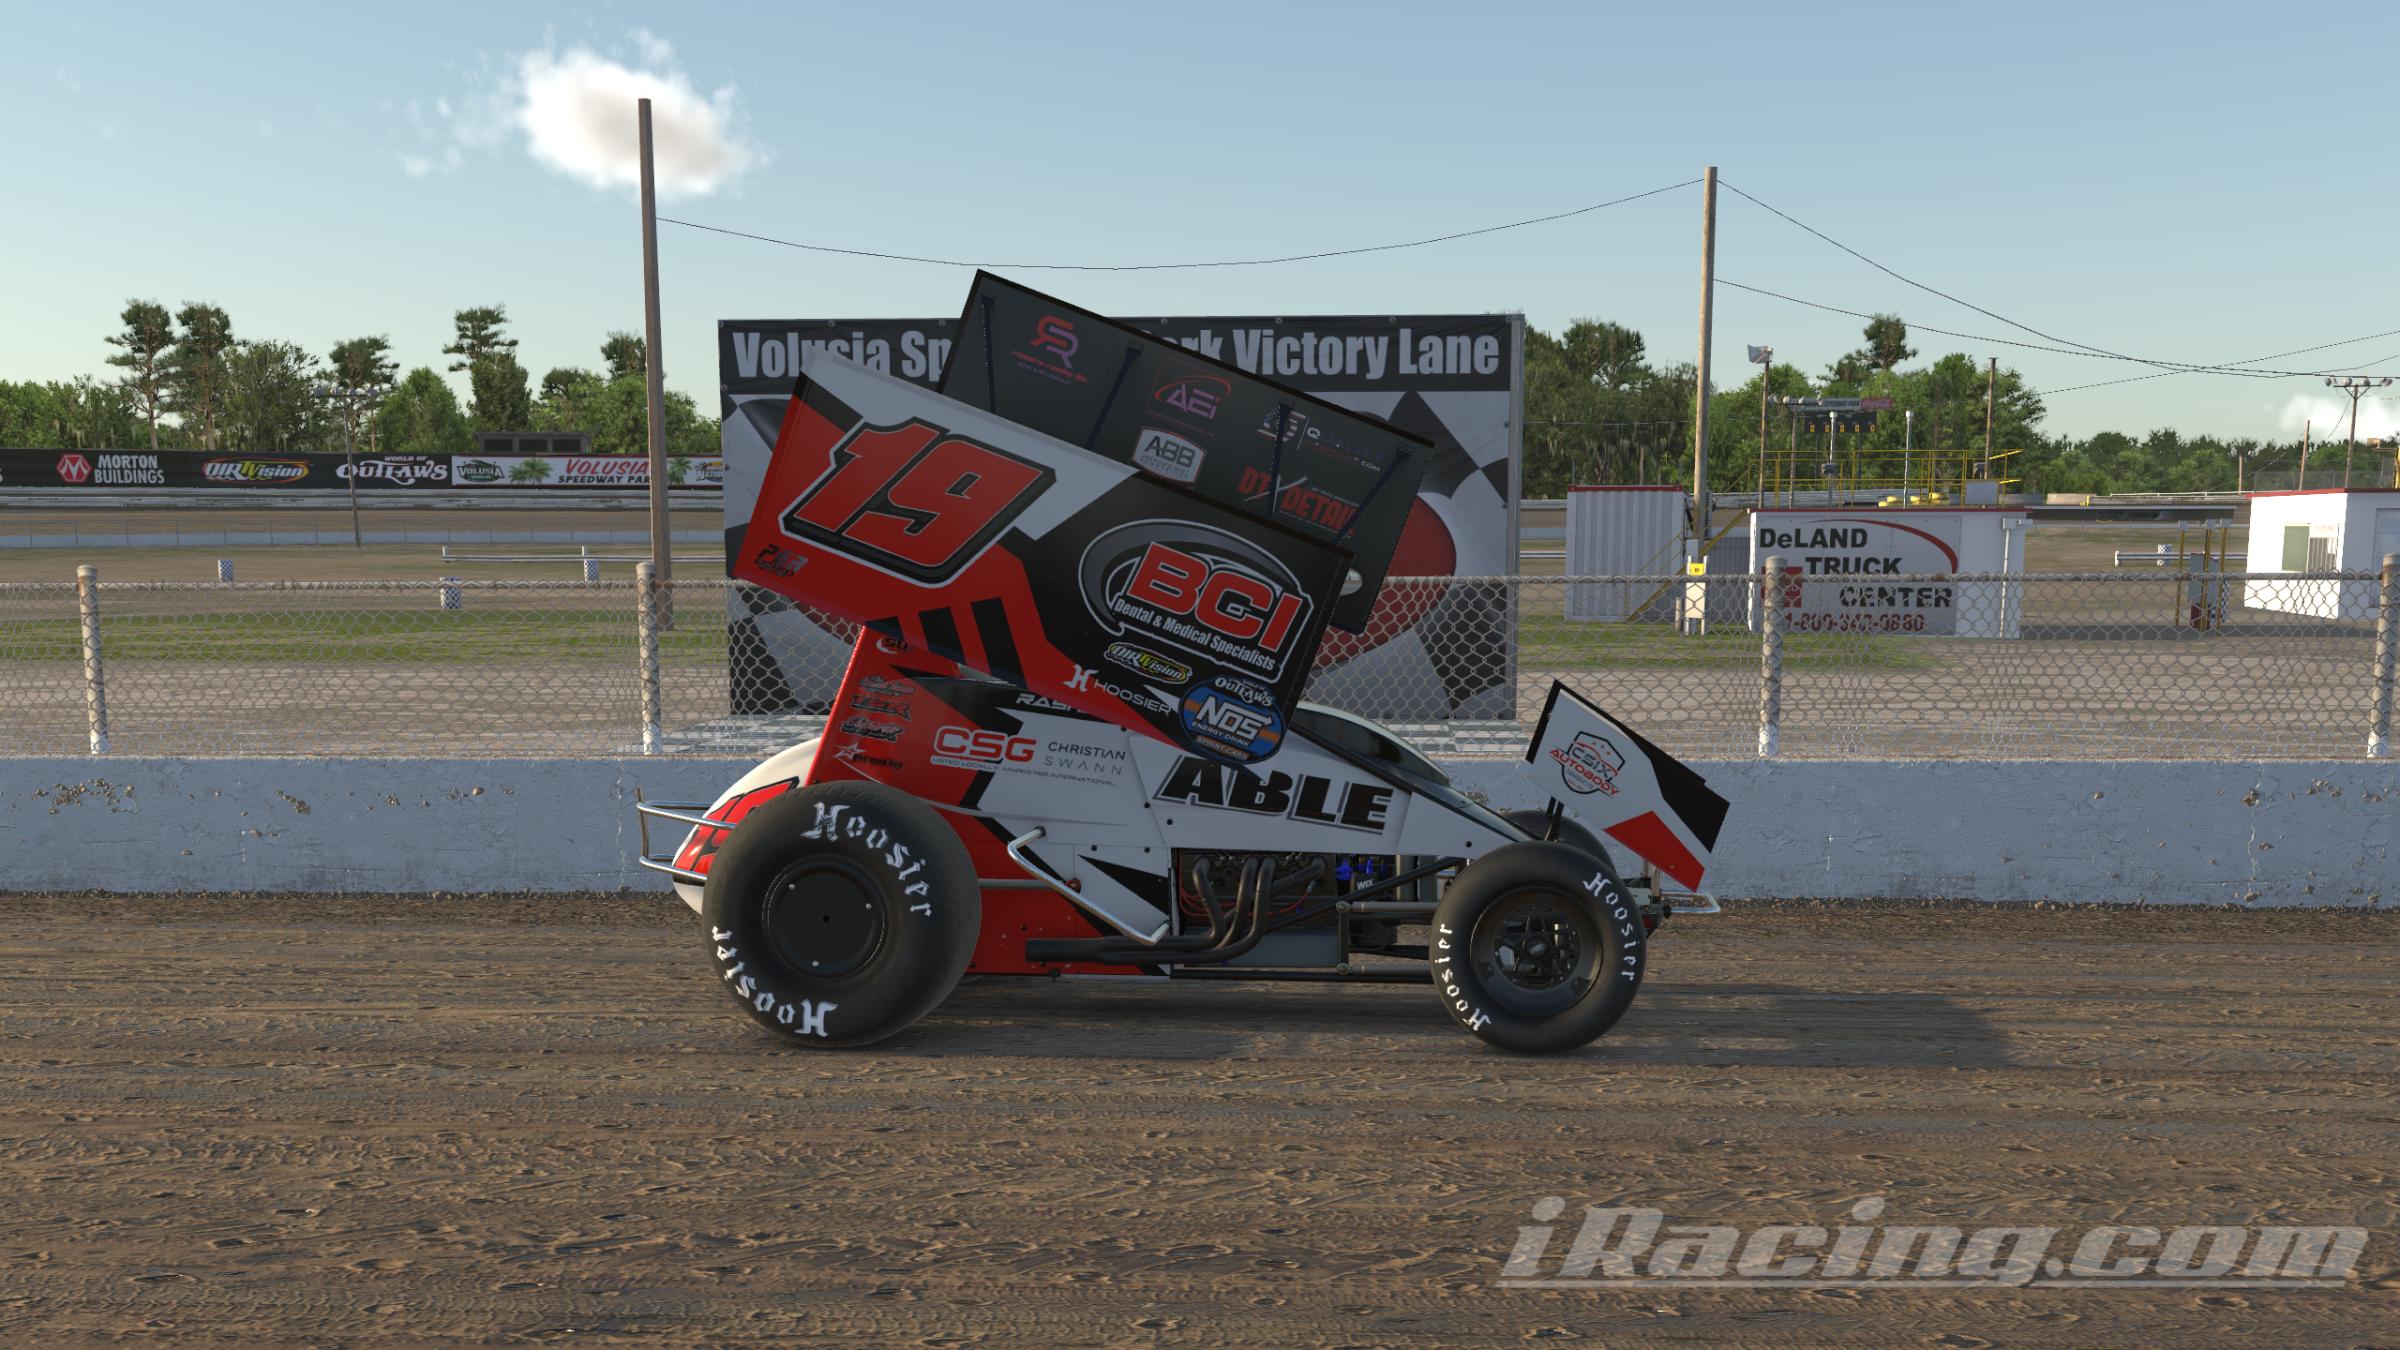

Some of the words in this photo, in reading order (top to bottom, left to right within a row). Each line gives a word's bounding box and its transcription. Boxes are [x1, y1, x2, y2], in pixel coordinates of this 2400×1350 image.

[732, 331, 891, 377] Volia
[1232, 328, 1389, 380] Victory
[1399, 328, 1500, 375] Lane
[98, 454, 158, 469] MORTON
[565, 458, 650, 475] VOLUSIA
[1144, 435, 1196, 468] ABB
[94, 469, 165, 484] BUILDINGS
[557, 475, 622, 484] SPEEDWAY
[626, 475, 651, 484] PAR
[783, 417, 1056, 585] 19
[1759, 528, 1868, 548] DeLAND
[1805, 557, 1903, 575] TRUCK
[1127, 542, 1303, 653] BCI
[1839, 586, 1952, 608] CENTER
[1114, 599, 1154, 625] Dental
[1155, 615, 1166, 627] &
[1162, 617, 1214, 648] Medical
[1209, 635, 1277, 673] Specialists
[1093, 680, 1174, 716] HOOSIER
[1196, 695, 1273, 741] NOS
[936, 728, 1037, 763] CSG
[1048, 741, 1126, 761] CHRISTIAN
[1223, 733, 1250, 748] DRINK
[932, 757, 960, 766] LISTED
[961, 761, 999, 770] LOCALLY
[1002, 767, 1049, 777] MARKETED
[1050, 773, 1115, 786] INTERNATIONAL
[1044, 756, 1124, 776] SWANN
[1550, 748, 1620, 796] AUTOBODY
[1155, 756, 1393, 833] ABLE
[800, 801, 932, 917] Hoosier
[1582, 872, 1640, 982] Hoosier
[711, 925, 839, 1038] Hoosier
[1435, 923, 1493, 1031] Hoosier
